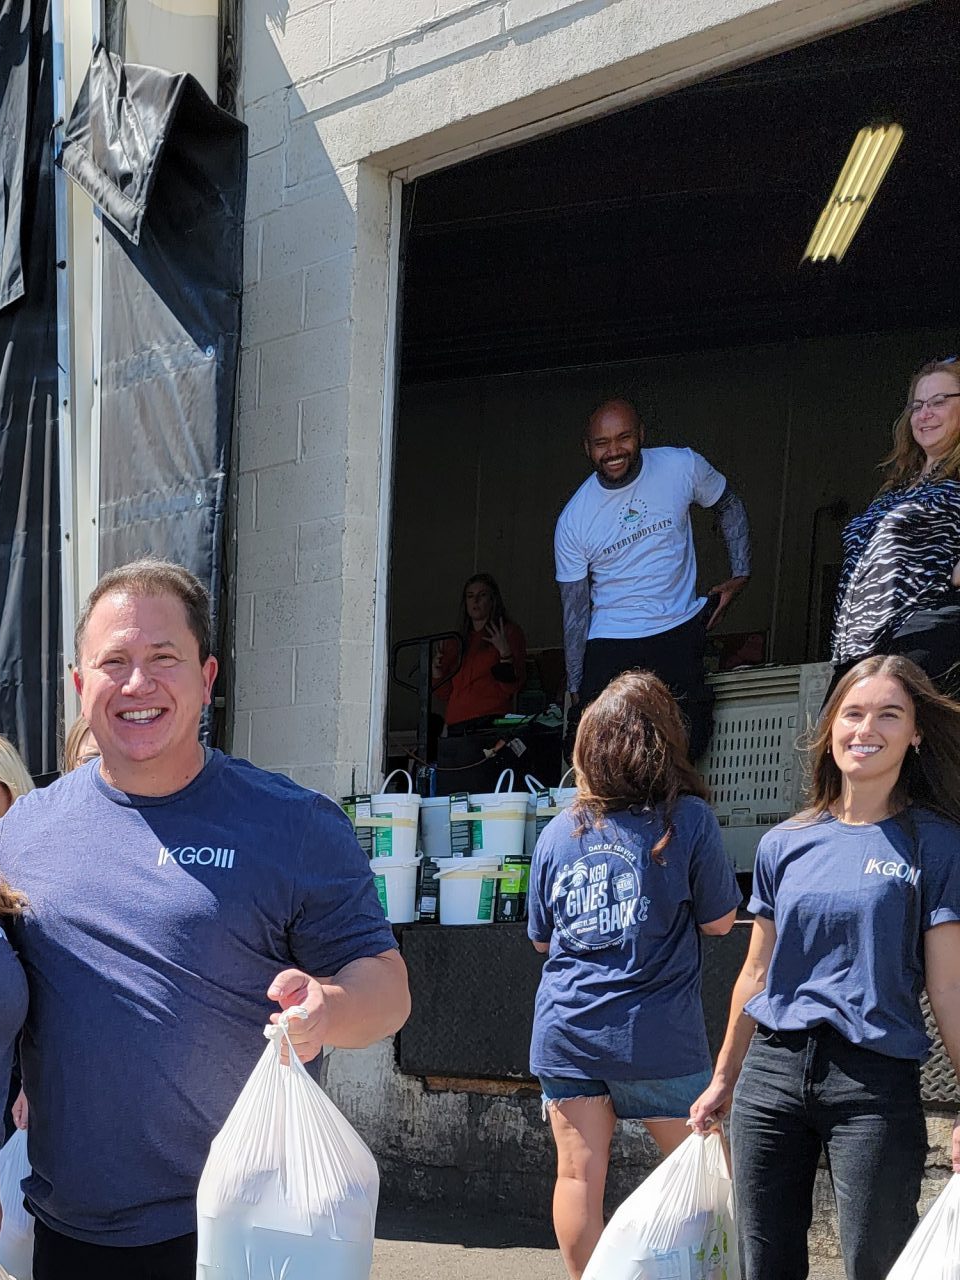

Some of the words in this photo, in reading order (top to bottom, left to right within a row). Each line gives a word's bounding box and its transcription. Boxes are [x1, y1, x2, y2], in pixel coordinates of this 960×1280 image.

[602, 517, 673, 555] #EVERYBODYEATS
[589, 844, 602, 852] DAY
[613, 844, 637, 862] SERVICE
[589, 863, 608, 884] KGO
[566, 881, 608, 918] GIVES
[599, 898, 638, 935] BACK
